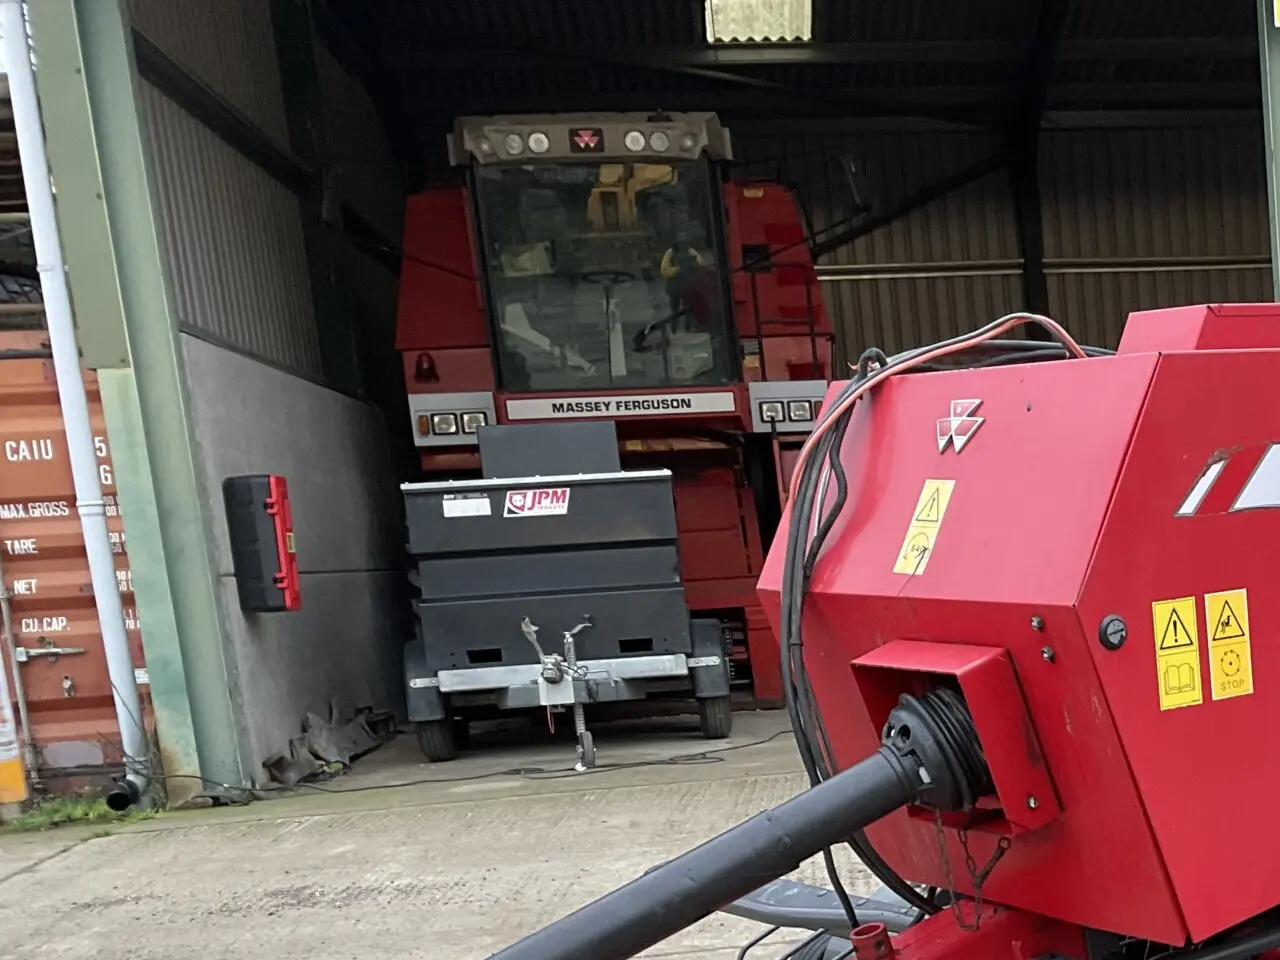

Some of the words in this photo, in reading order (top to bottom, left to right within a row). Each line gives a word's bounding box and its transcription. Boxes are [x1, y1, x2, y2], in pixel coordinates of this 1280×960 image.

[551, 401, 612, 413] MASSEY
[615, 398, 692, 411] FERGUSON
[5, 439, 53, 461] CAIU
[527, 489, 568, 511] JPM
[0, 501, 69, 519] MAX.GROSS
[4, 538, 39, 555] TARE
[13, 579, 38, 595] NET
[21, 616, 71, 633] CU.CAP.
[1221, 679, 1245, 691] STOP
